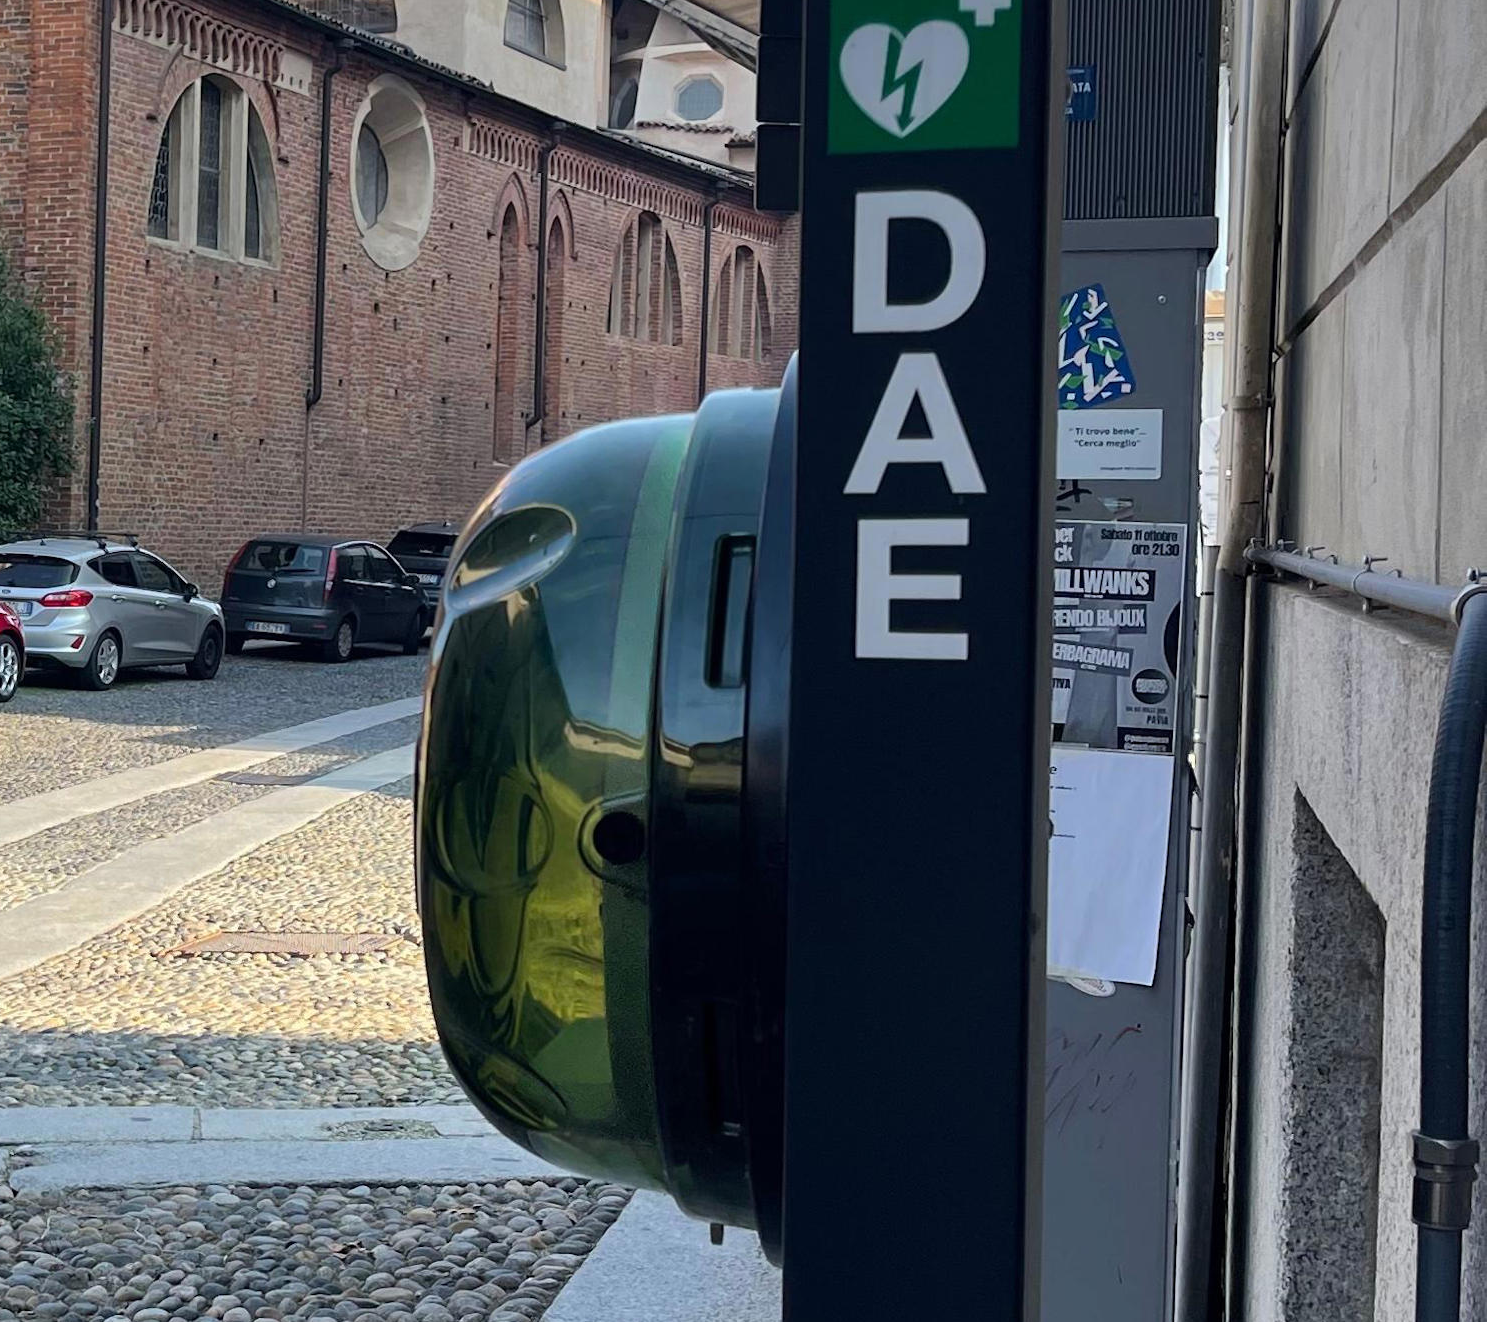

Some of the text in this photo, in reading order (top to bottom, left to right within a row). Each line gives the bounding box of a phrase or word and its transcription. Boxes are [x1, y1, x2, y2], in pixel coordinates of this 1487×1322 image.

[843, 189, 988, 661] DAE
[1101, 528, 1133, 541] Sabato
[1144, 530, 1178, 542] ottobre
[1132, 544, 1150, 555] ore
